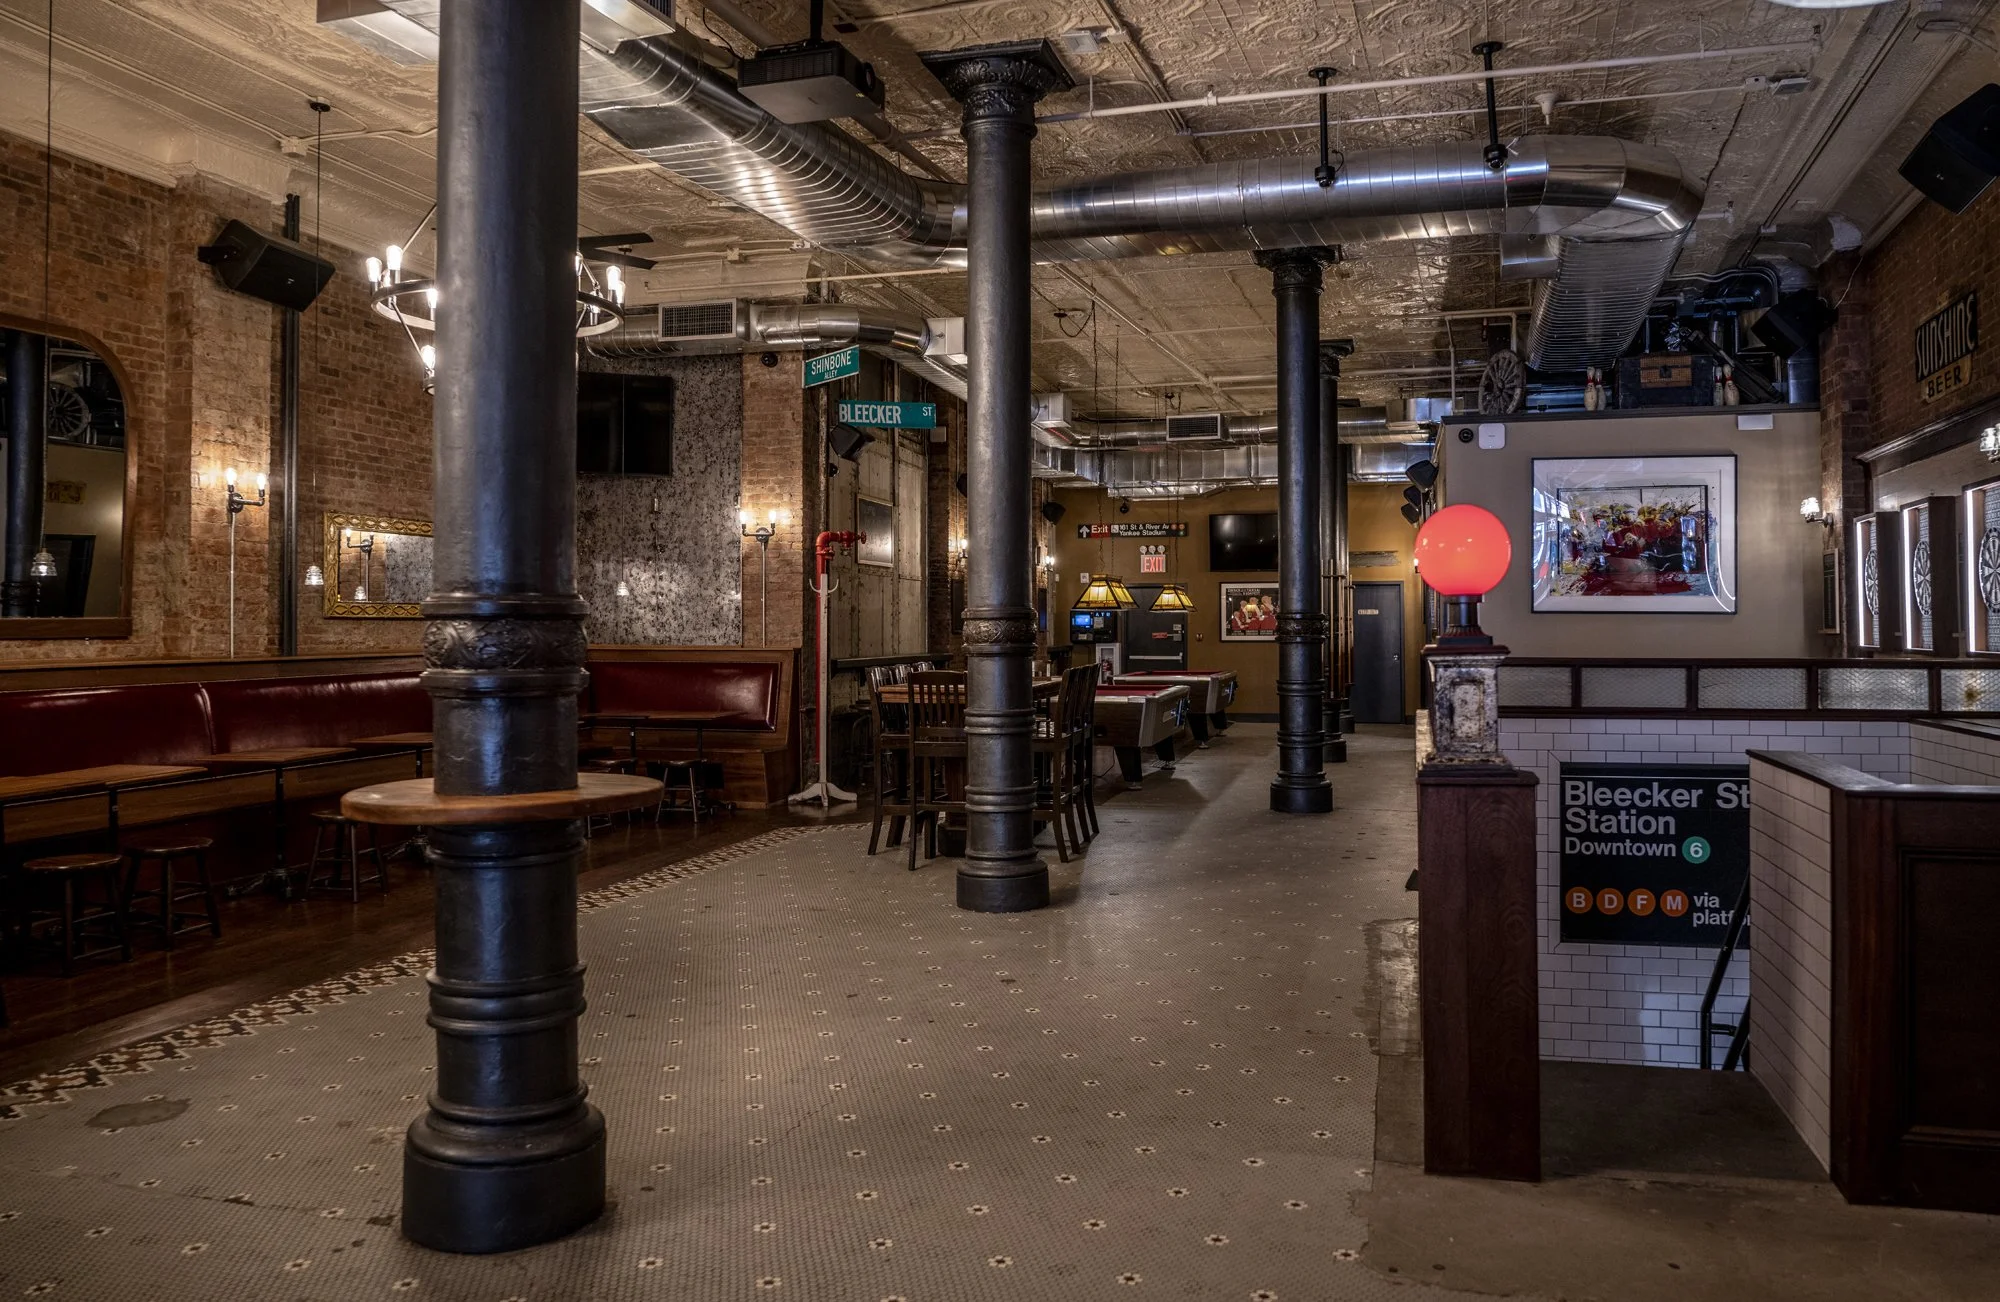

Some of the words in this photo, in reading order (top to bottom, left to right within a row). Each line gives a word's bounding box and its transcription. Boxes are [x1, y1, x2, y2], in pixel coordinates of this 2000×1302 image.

[1916, 293, 1975, 379] SUNSHINE
[811, 350, 852, 376] SHINBONE
[823, 368, 838, 380] ALLEY
[1927, 365, 1962, 398] BEER
[839, 403, 901, 424] BLEECKER
[922, 406, 933, 417] ST
[1091, 524, 1109, 534] Exit
[1144, 556, 1164, 573] EXIT
[1564, 781, 1703, 808] Bleecker
[1716, 782, 1750, 809] St
[1565, 808, 1676, 835] Station
[1565, 836, 1677, 857] Downtown
[1689, 843, 1703, 858] 6
[1572, 892, 1586, 908] B
[1604, 894, 1617, 909] D
[1636, 895, 1648, 910] F
[1666, 896, 1682, 911] M
[1693, 892, 1720, 908] via
